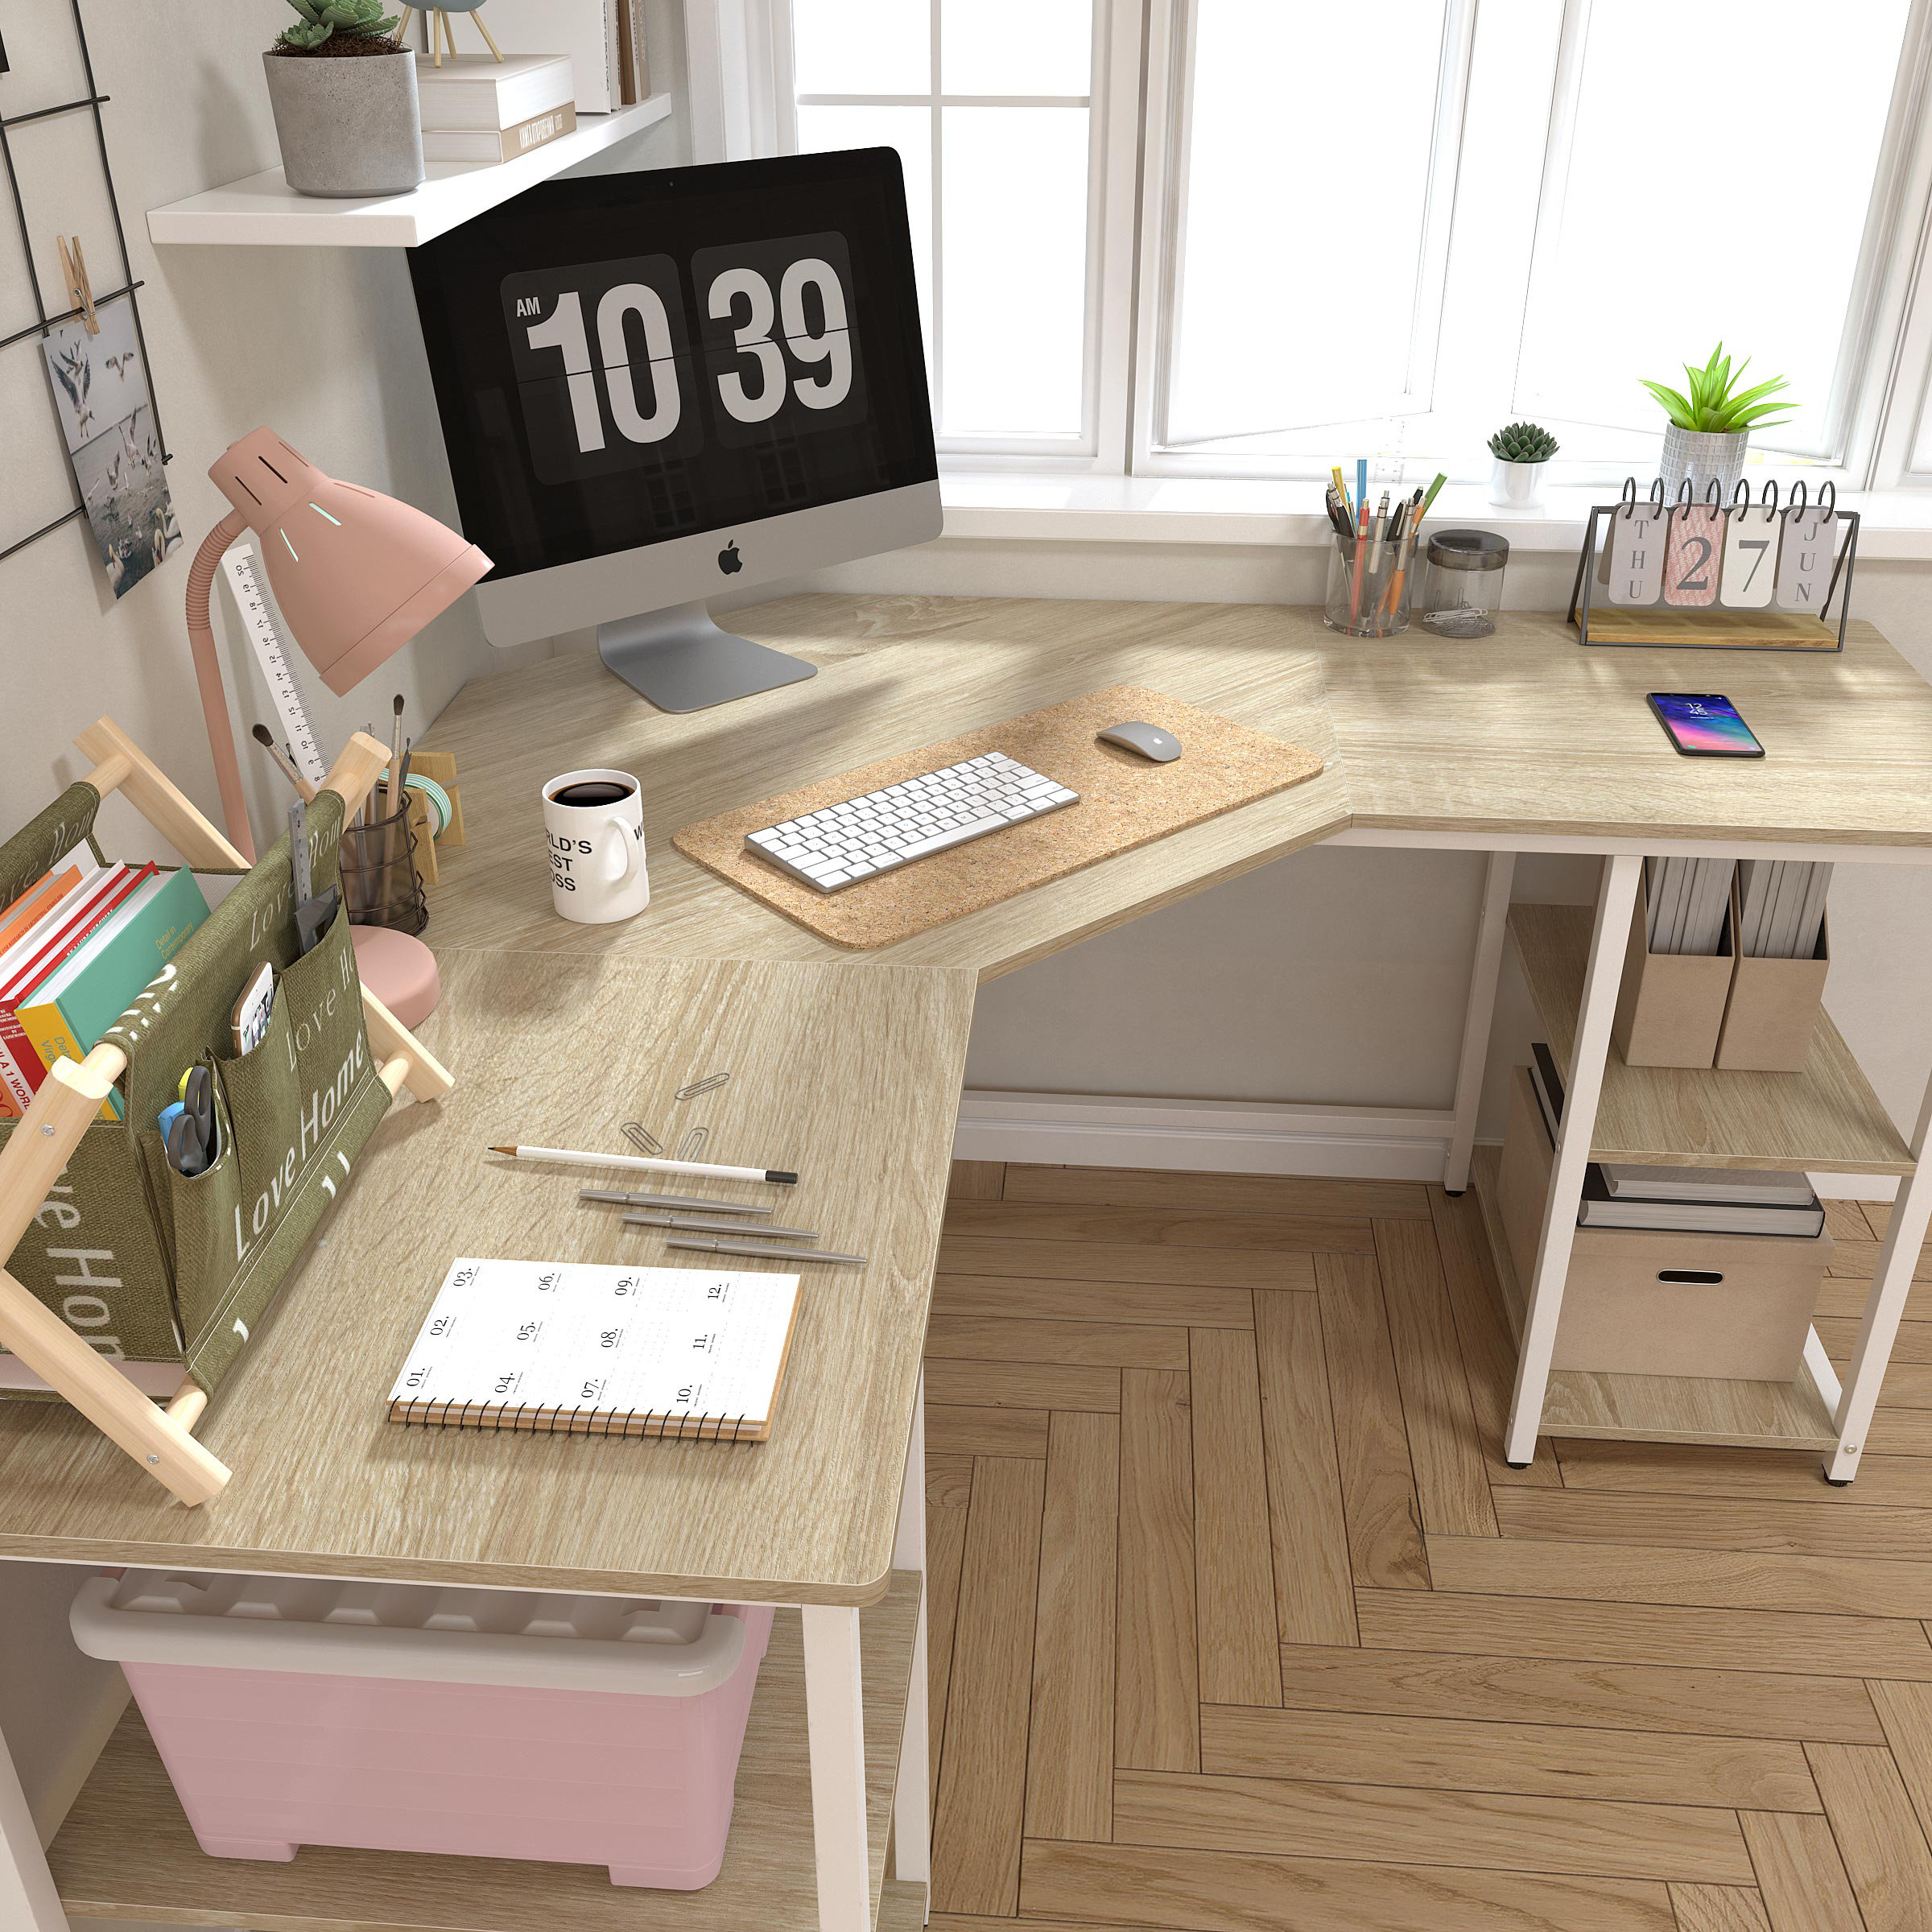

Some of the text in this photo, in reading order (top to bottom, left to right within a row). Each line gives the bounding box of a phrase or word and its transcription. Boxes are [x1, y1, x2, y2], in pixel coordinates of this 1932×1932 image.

[517, 296, 541, 317] AM
[708, 258, 852, 423] 39
[526, 283, 681, 453] 10
[309, 815, 341, 869] Hom
[546, 827, 592, 854] RLD'S
[548, 848, 573, 872] EST
[286, 987, 336, 1072] Love
[10, 1079, 31, 1110] WORL
[234, 1146, 296, 1262] Love
[301, 1029, 365, 1162] Home
[453, 1268, 473, 1286] 03.
[539, 1273, 555, 1290] 06.
[614, 1277, 633, 1295] 09.
[708, 1284, 722, 1299] 12.
[430, 1316, 449, 1335] 02.
[517, 1322, 536, 1340] 05.
[601, 1328, 618, 1348] 08.
[692, 1334, 708, 1349] 11.
[407, 1368, 426, 1387] 01.
[494, 1373, 515, 1393] 04.
[581, 1379, 600, 1398] 07.
[676, 1385, 693, 1403] 10.
